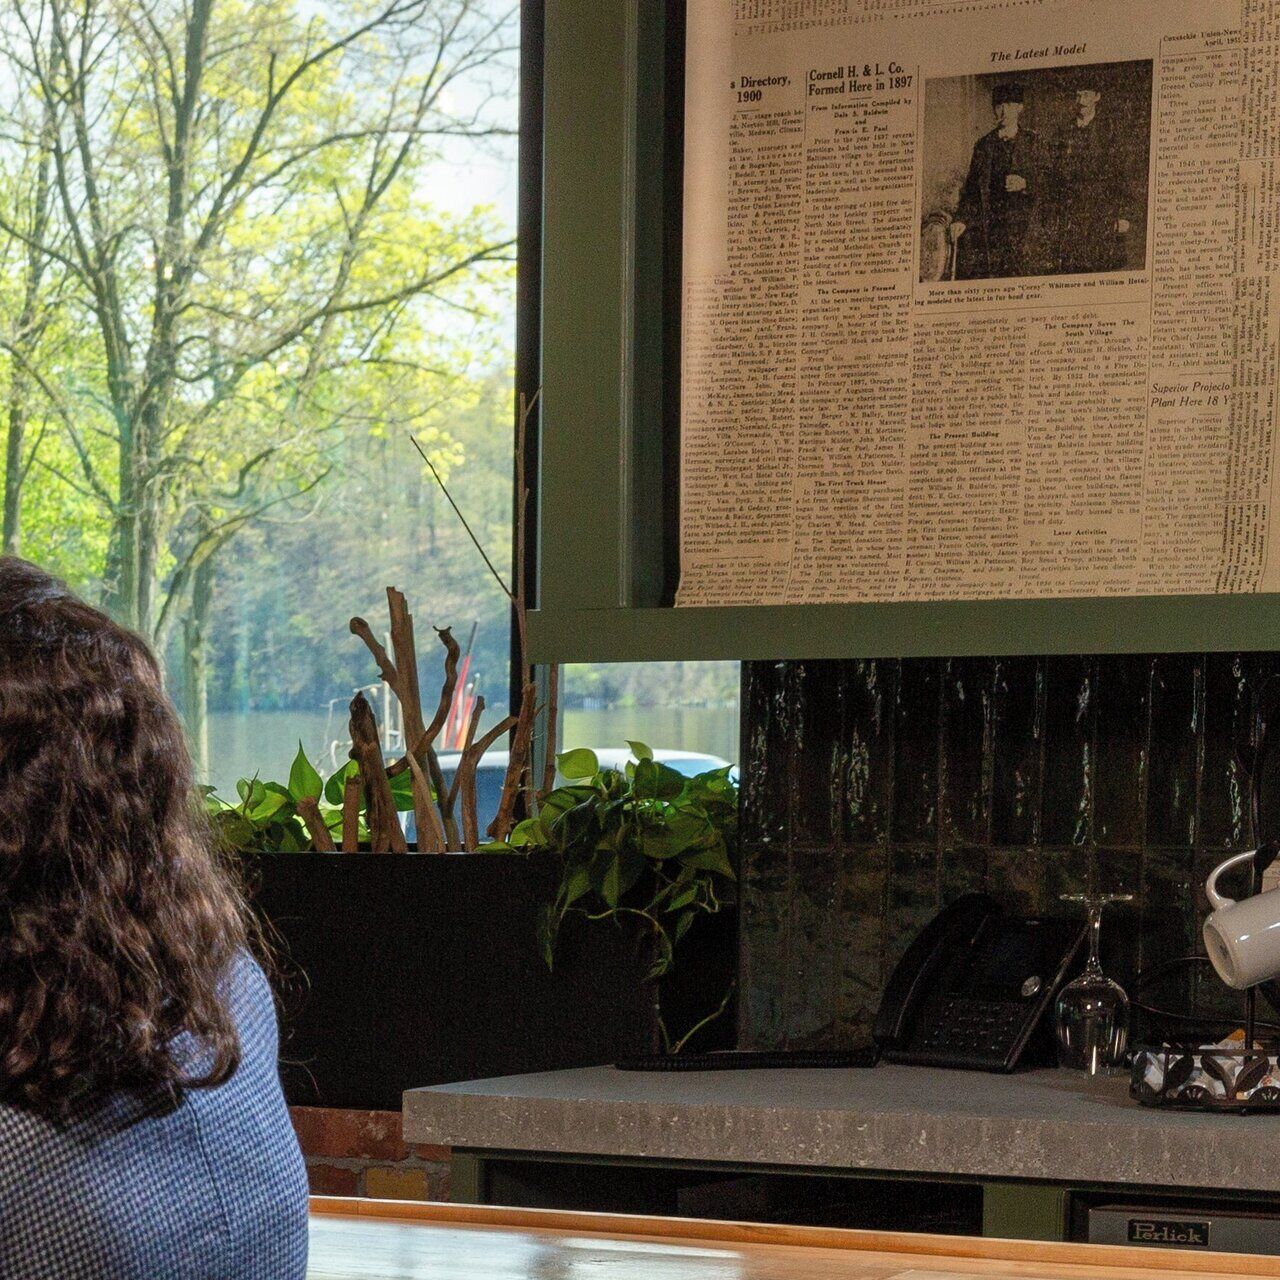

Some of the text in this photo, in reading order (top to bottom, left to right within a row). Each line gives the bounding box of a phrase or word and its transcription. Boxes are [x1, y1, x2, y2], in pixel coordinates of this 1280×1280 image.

[990, 44, 1086, 61] The Latest Model
[809, 62, 904, 81] Cornell H. & L. Co.
[740, 76, 790, 88] Directory,
[808, 75, 912, 96] Formed Here in 1897
[737, 90, 762, 102] 1900
[1151, 382, 1187, 396] Superior
[1150, 396, 1175, 407] Plant
[1179, 395, 1202, 406] Here
[1206, 395, 1218, 405] 18
[1133, 1222, 1203, 1244] Perlick
